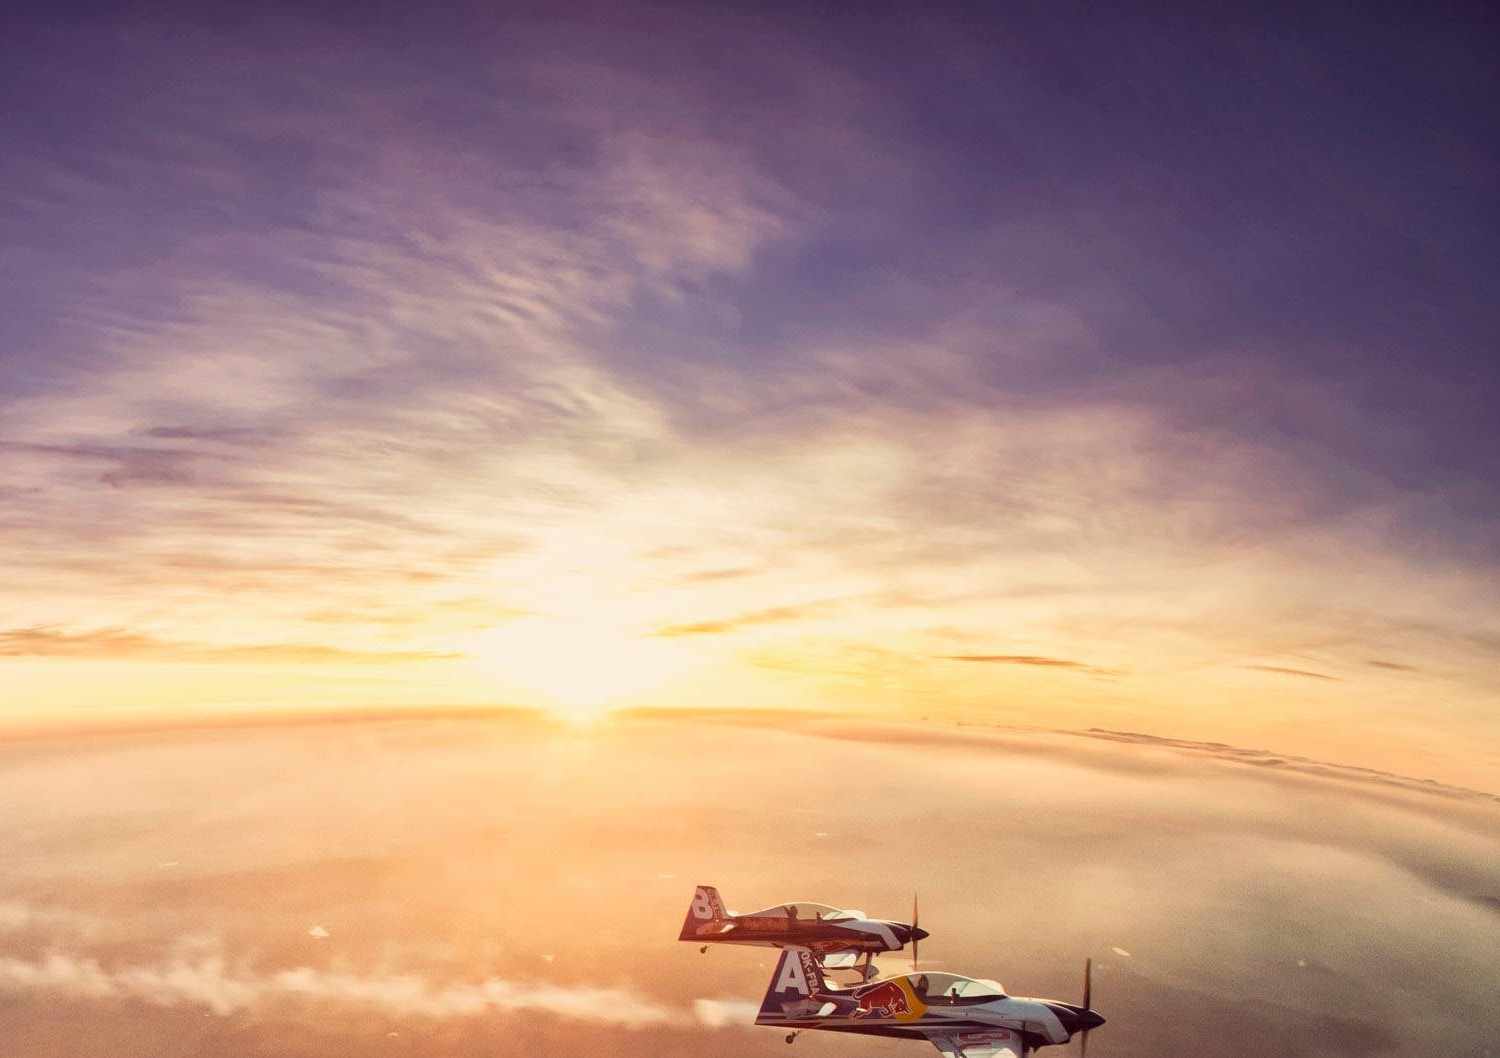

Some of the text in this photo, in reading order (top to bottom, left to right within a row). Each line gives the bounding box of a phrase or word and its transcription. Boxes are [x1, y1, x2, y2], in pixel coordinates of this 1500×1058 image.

[691, 888, 714, 920] B
[774, 949, 810, 995] A
[801, 951, 820, 995] OK-FBA
